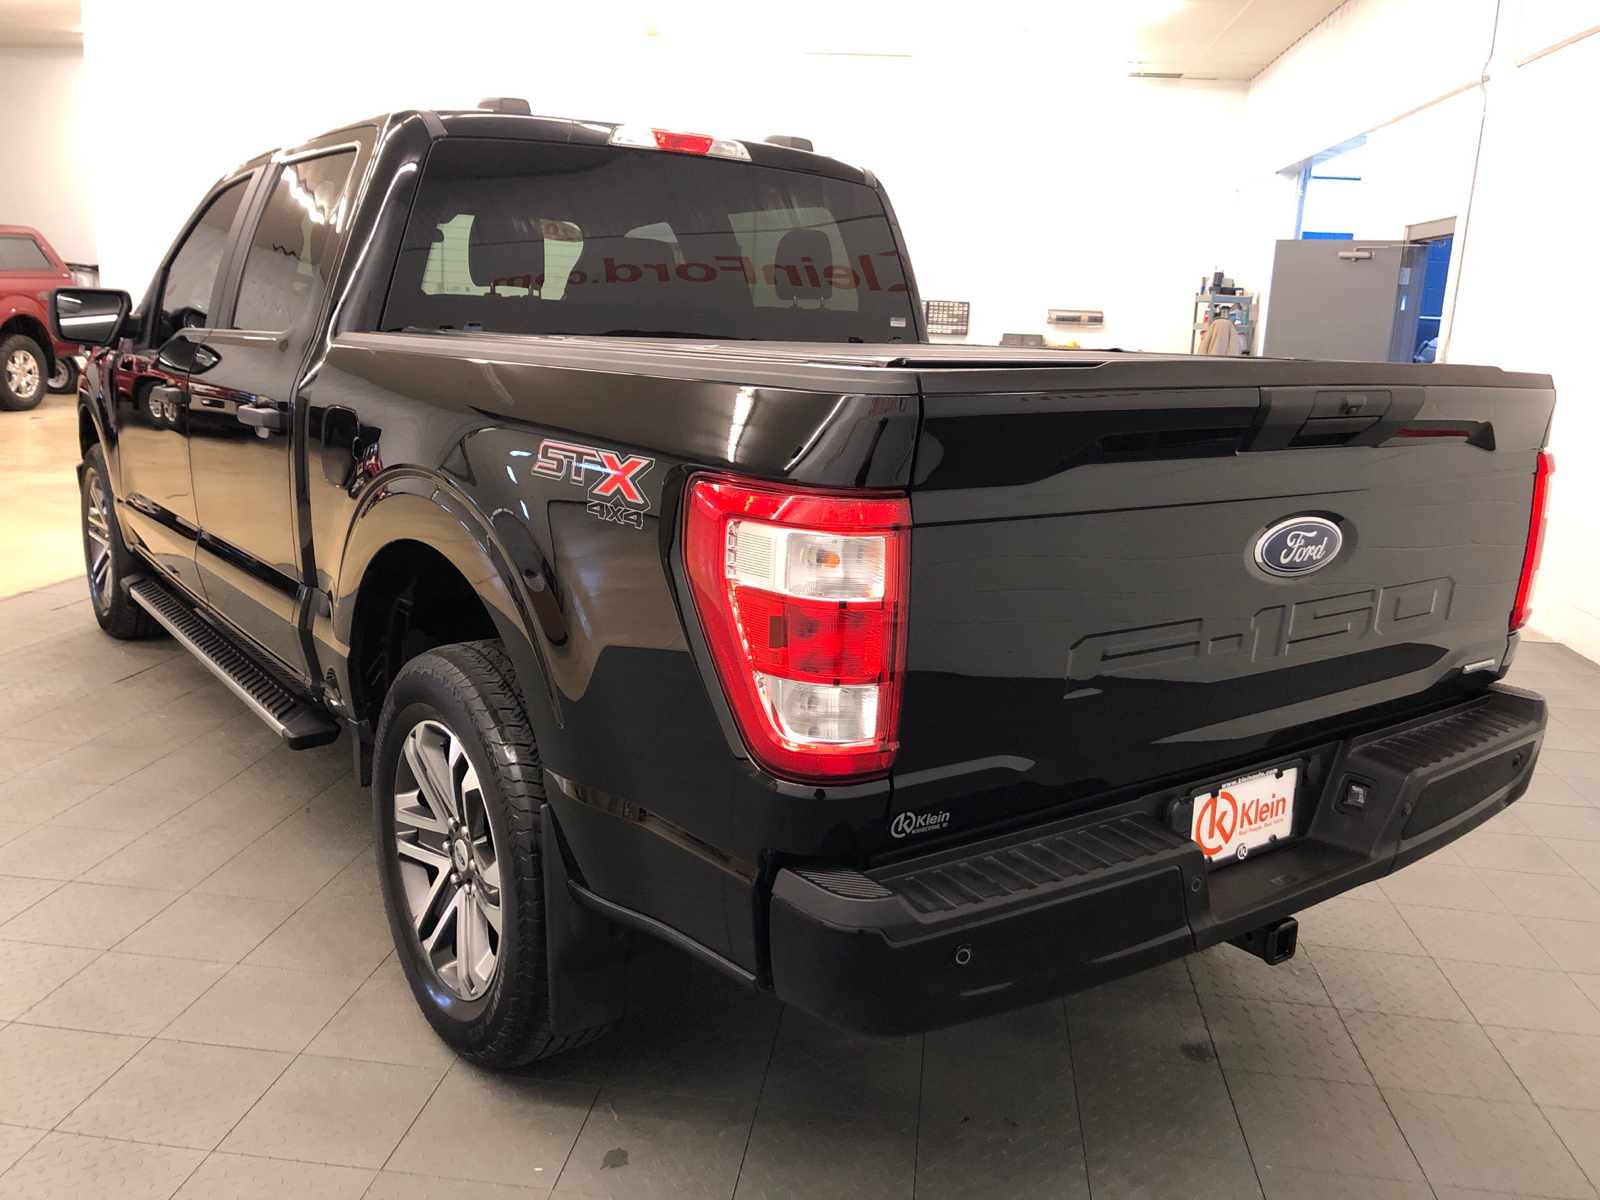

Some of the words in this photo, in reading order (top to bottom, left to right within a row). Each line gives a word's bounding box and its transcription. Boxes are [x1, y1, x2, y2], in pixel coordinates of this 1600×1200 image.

[531, 438, 655, 513] STX
[1280, 531, 1327, 564] Ford
[1063, 576, 1456, 699] F-150
[916, 811, 950, 828] Klein
[1239, 793, 1287, 829] Klein
